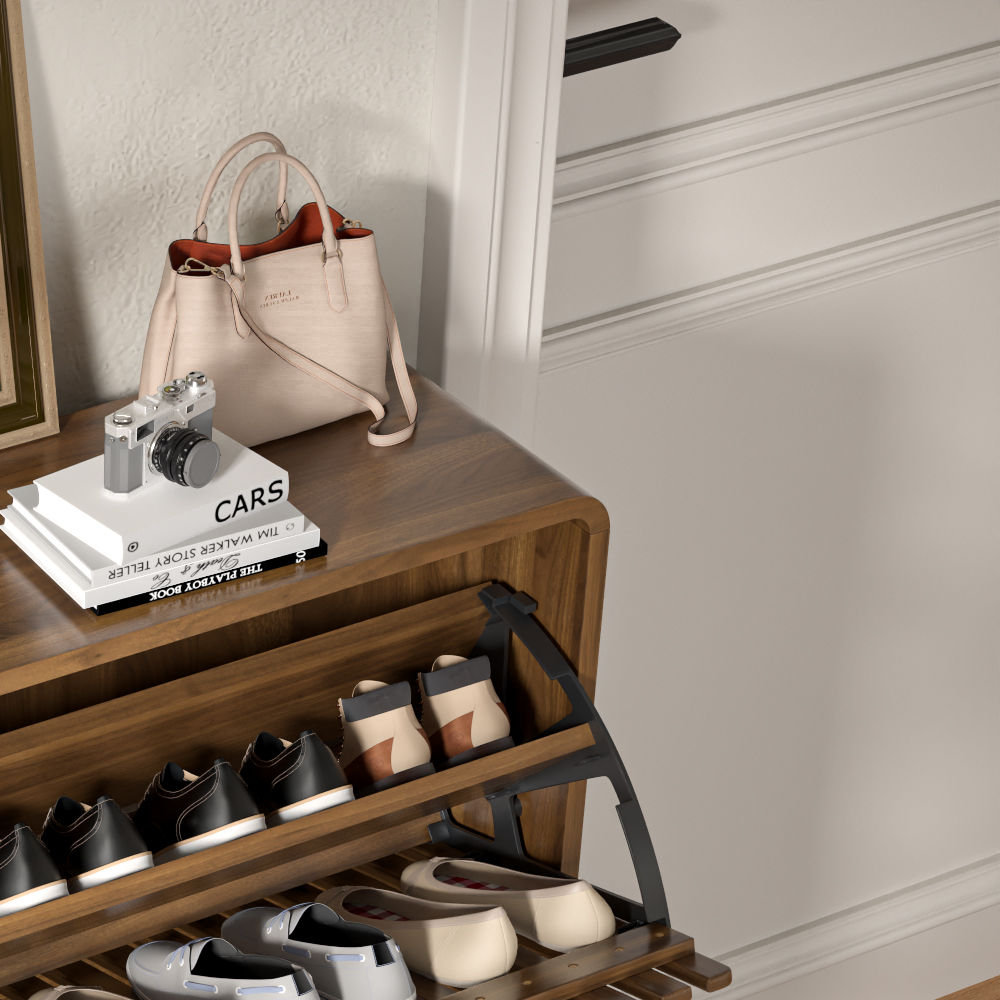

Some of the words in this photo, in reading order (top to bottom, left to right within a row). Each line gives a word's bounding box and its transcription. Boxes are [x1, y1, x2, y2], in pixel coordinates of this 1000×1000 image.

[215, 480, 283, 522] CARS
[257, 526, 279, 539] TIM
[200, 534, 253, 555] WALKER
[155, 548, 196, 568] STORY
[108, 560, 150, 580] TELLER
[240, 563, 263, 577] THE
[184, 569, 238, 592] PLAYBOY
[149, 584, 182, 601] BOOK
